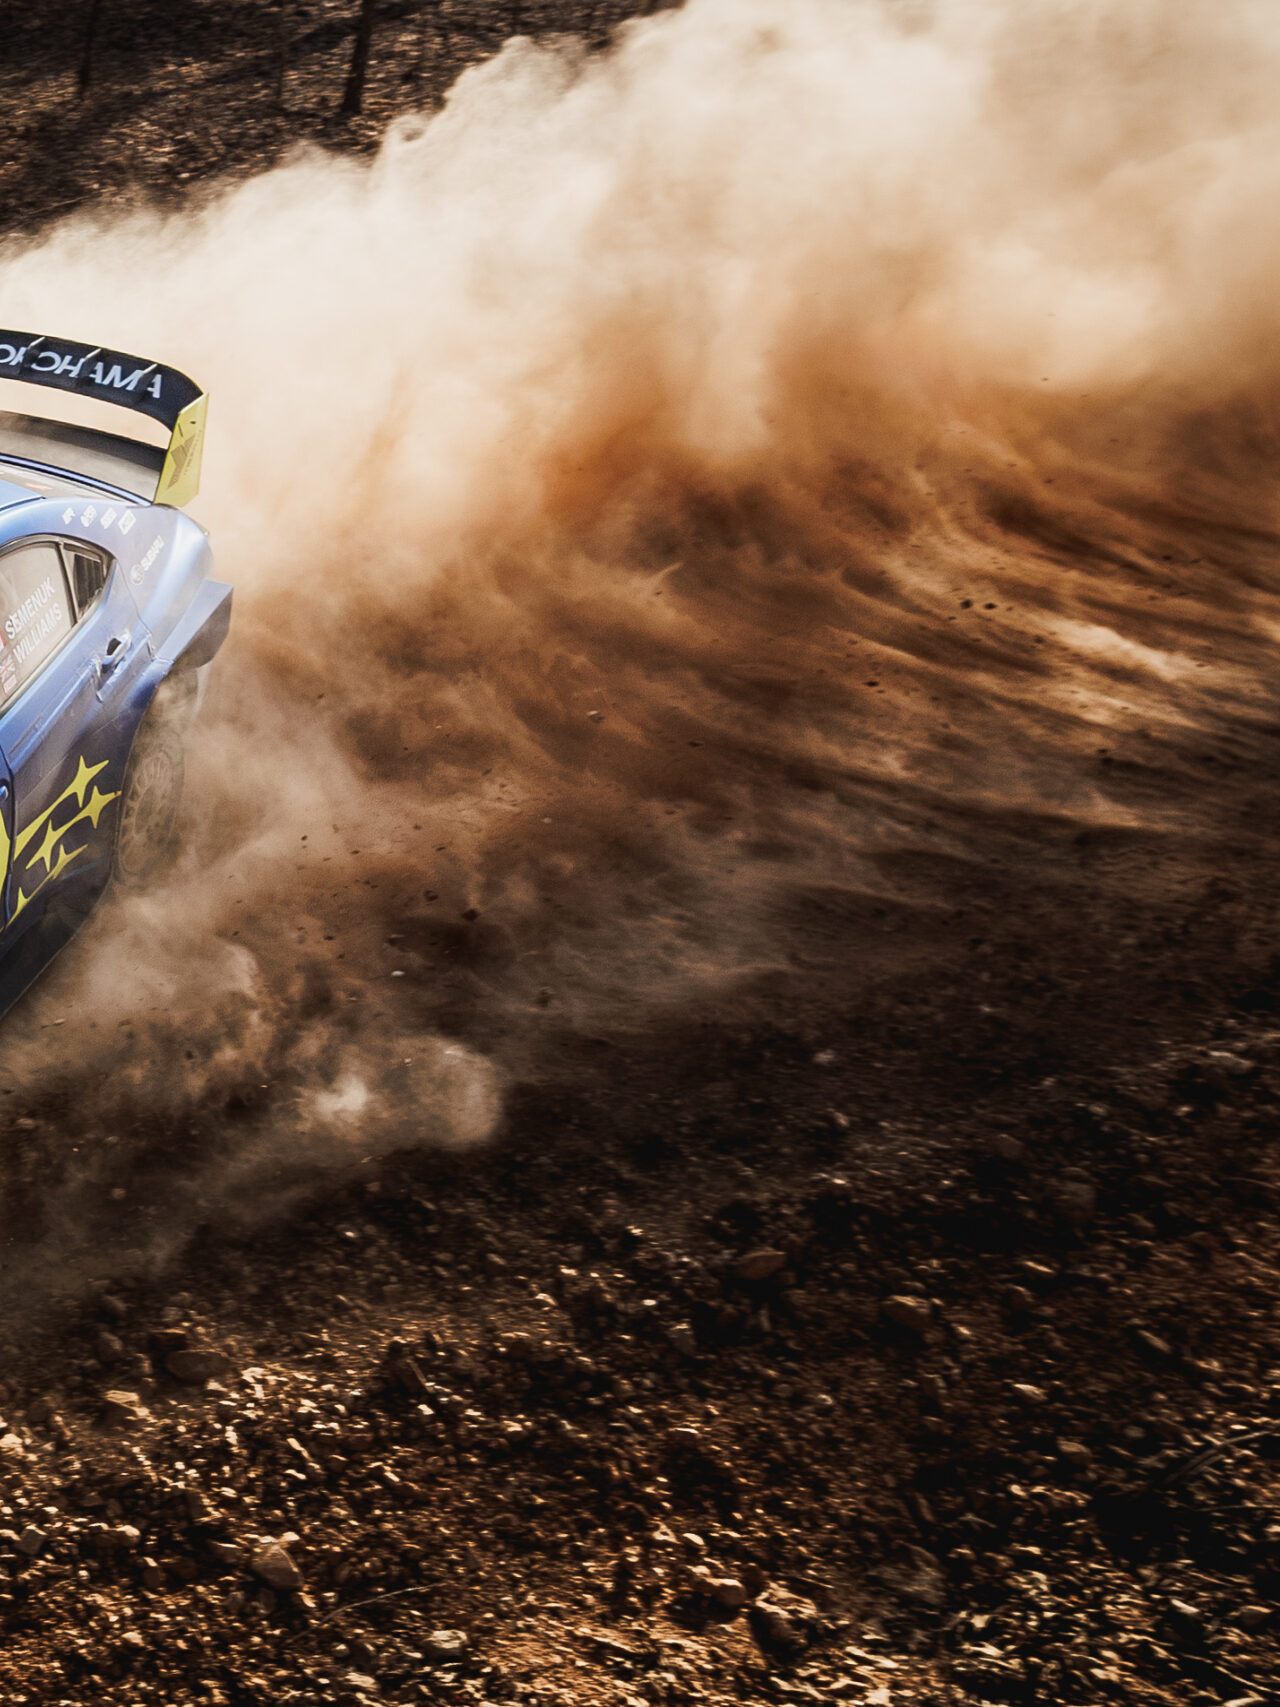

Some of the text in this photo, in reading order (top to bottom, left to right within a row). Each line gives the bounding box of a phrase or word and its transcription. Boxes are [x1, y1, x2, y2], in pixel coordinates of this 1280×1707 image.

[140, 535, 165, 571] SUBARU
[5, 576, 56, 640] SEMENUK
[12, 602, 62, 664] WILLIAMS
